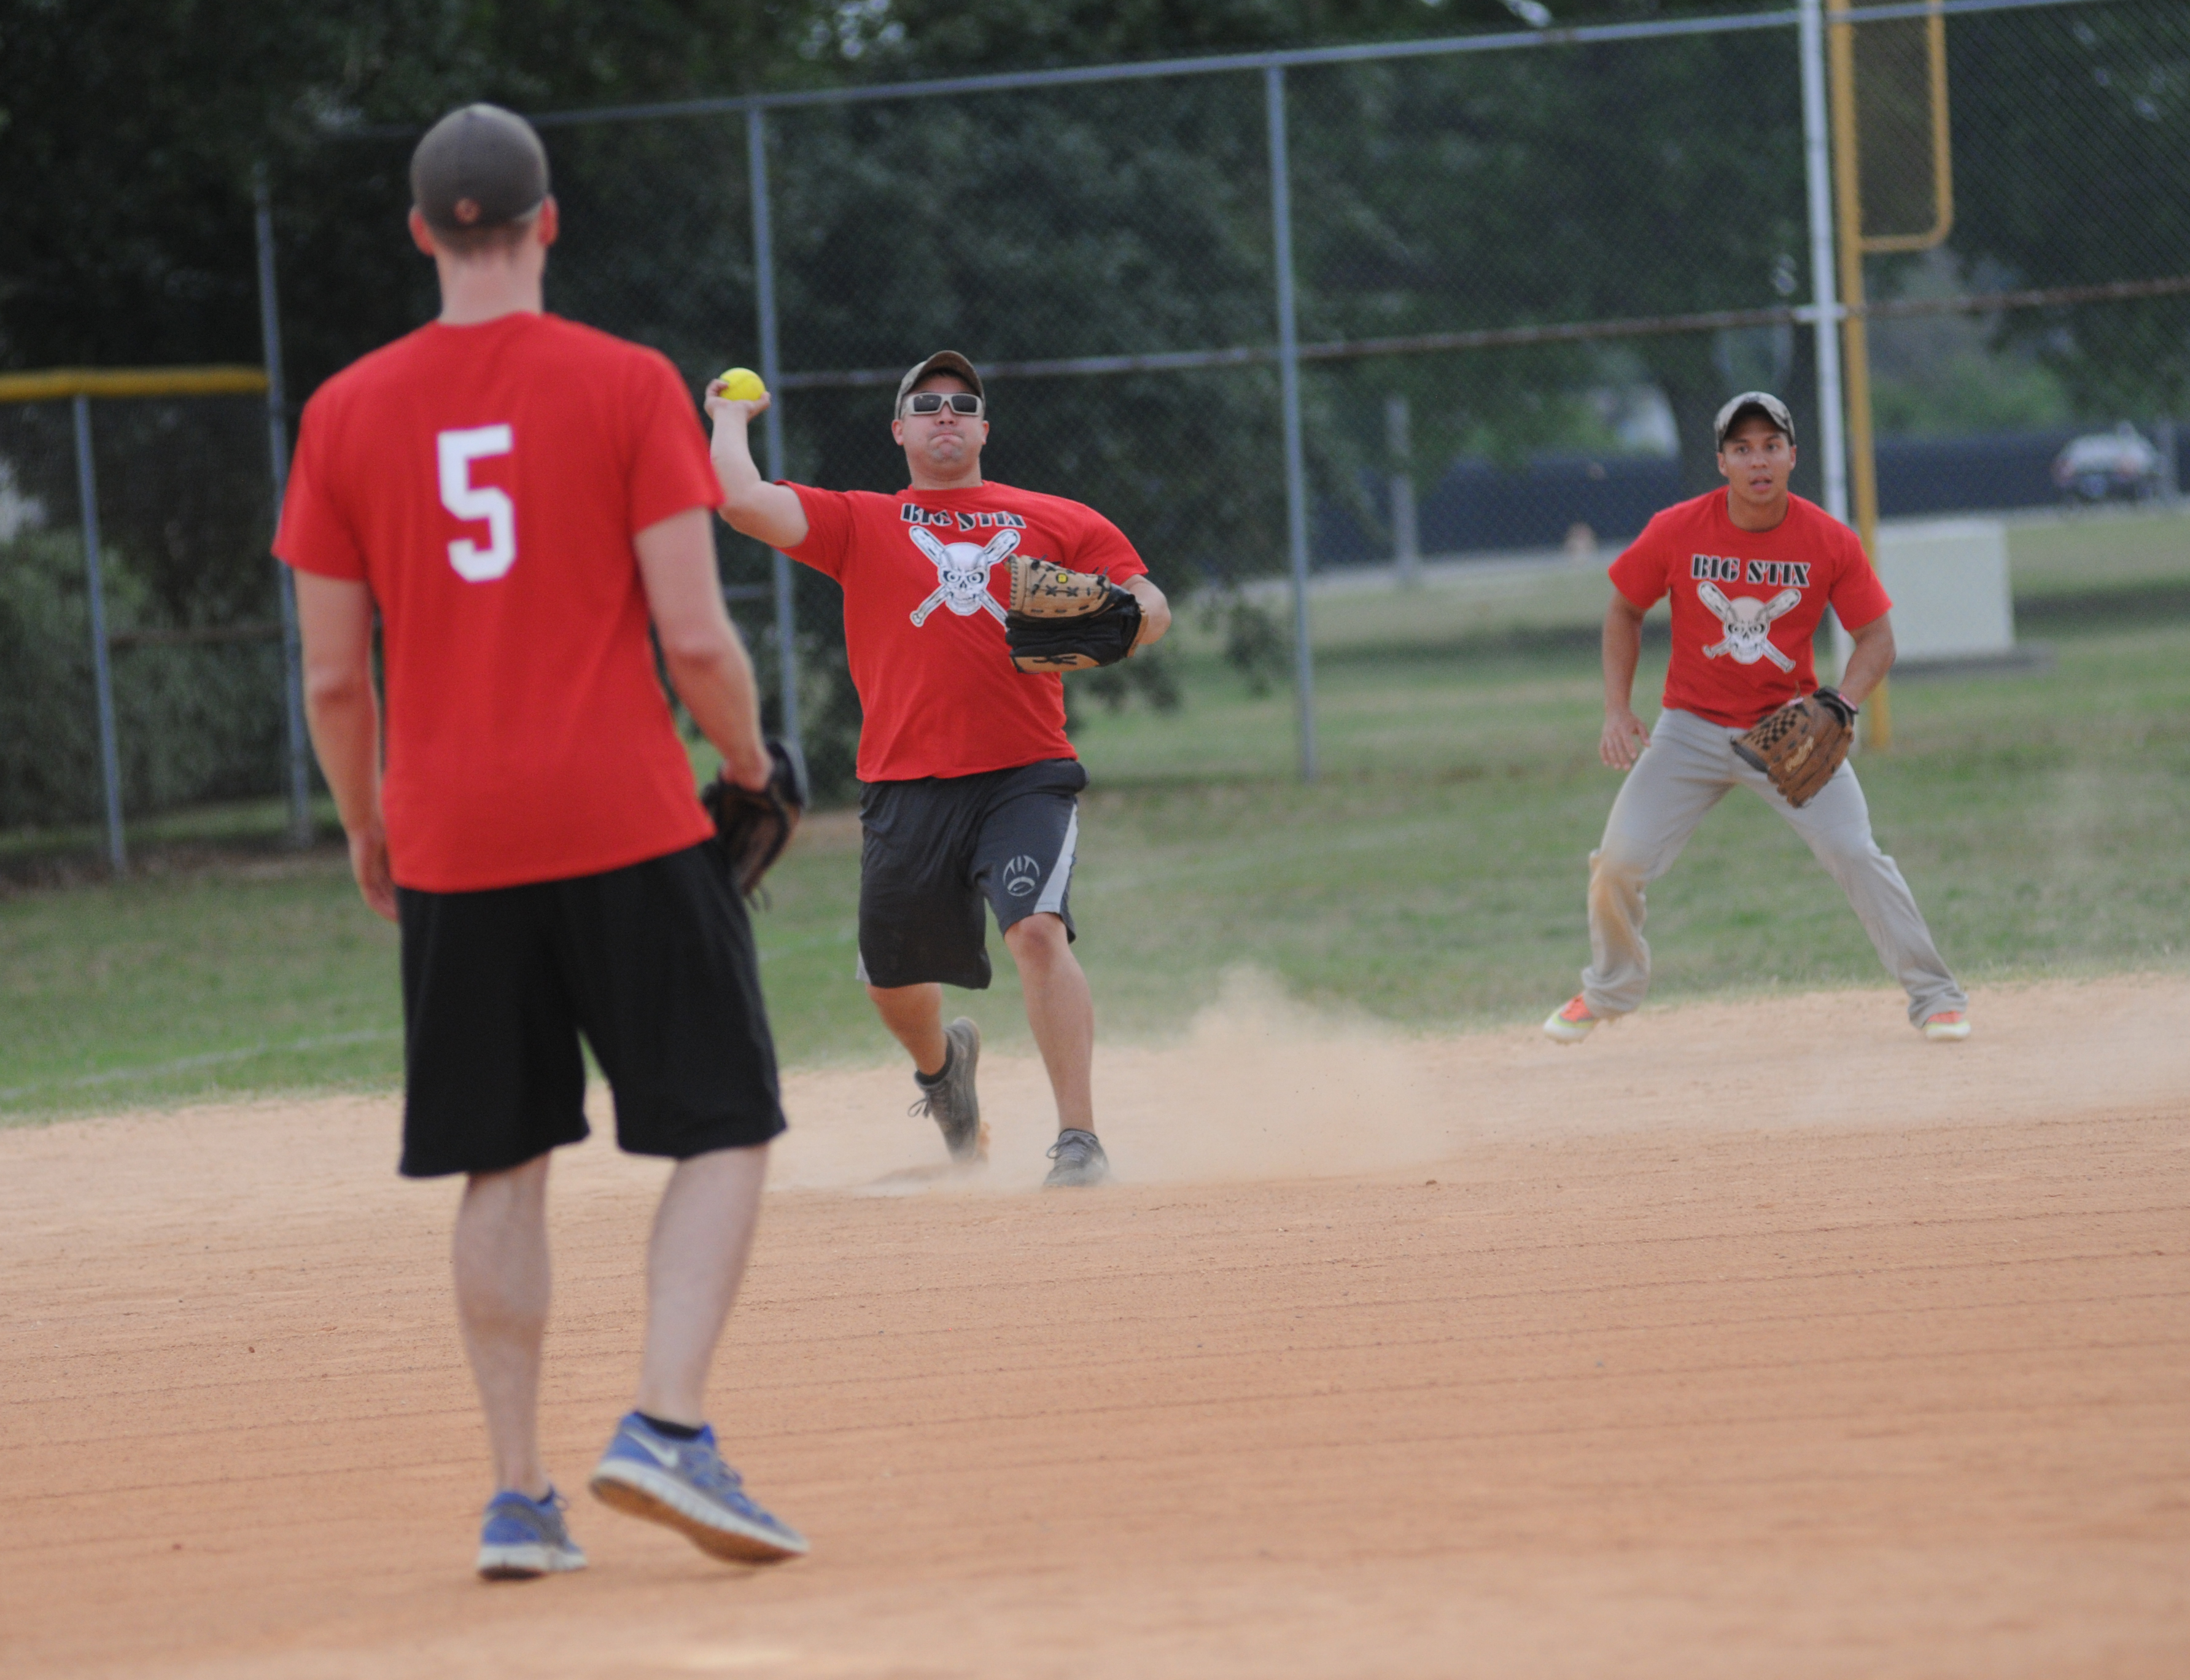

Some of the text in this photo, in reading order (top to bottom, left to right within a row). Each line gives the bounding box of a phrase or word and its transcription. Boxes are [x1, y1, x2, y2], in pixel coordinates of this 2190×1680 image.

[437, 423, 516, 583] 5
[1691, 553, 1811, 588] BIG STIX
